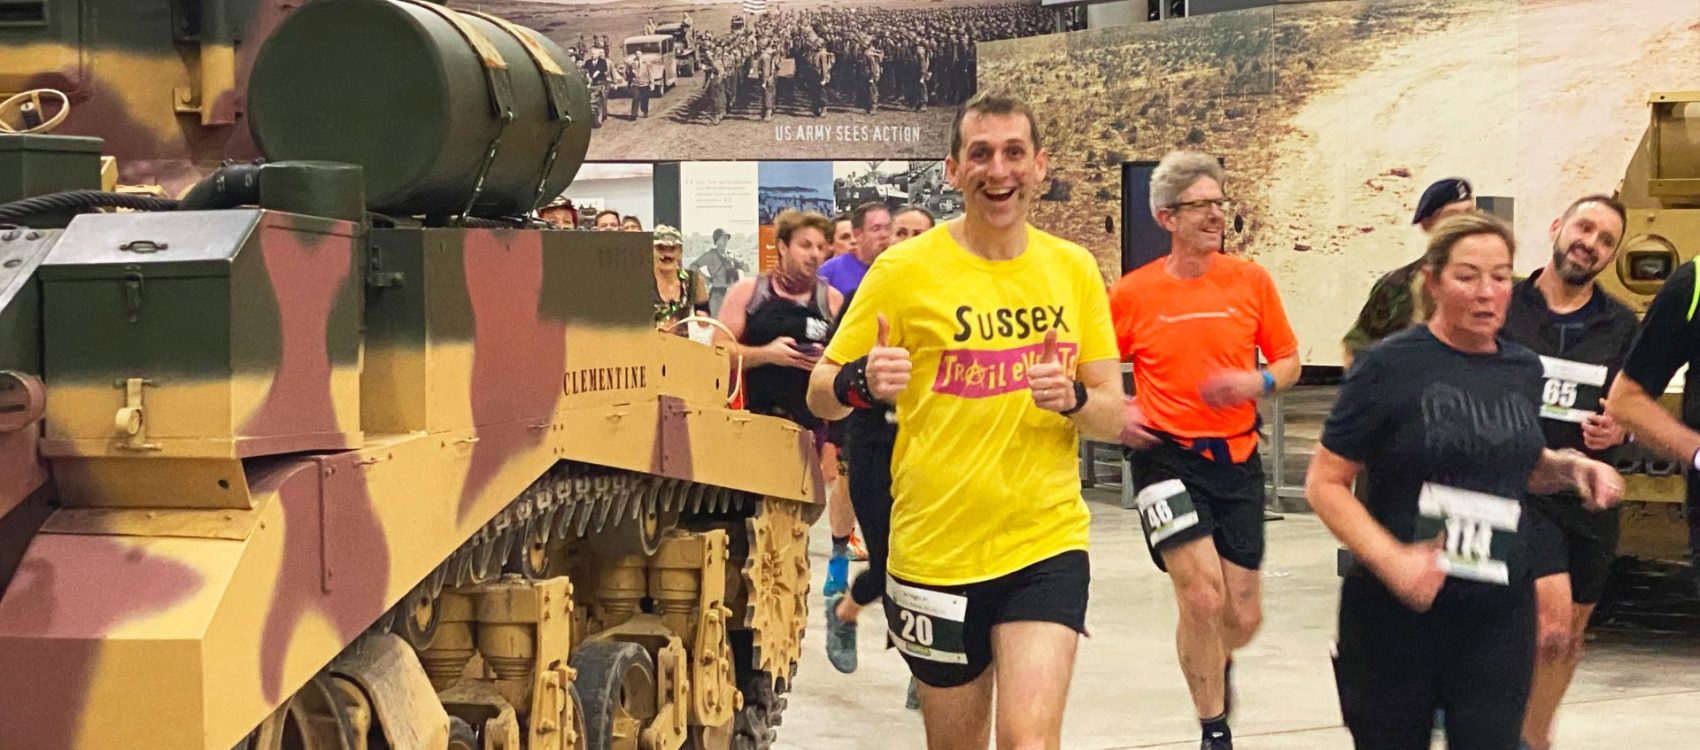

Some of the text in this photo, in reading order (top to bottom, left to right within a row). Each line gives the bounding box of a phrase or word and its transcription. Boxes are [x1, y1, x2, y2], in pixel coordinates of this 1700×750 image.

[775, 125, 920, 142] US ARMY SEES ACTION
[953, 305, 1070, 342] Sussex
[563, 365, 646, 396] CLEMENTINE
[1542, 377, 1578, 408] 65
[1147, 500, 1174, 529] 46
[900, 609, 934, 646] 20
